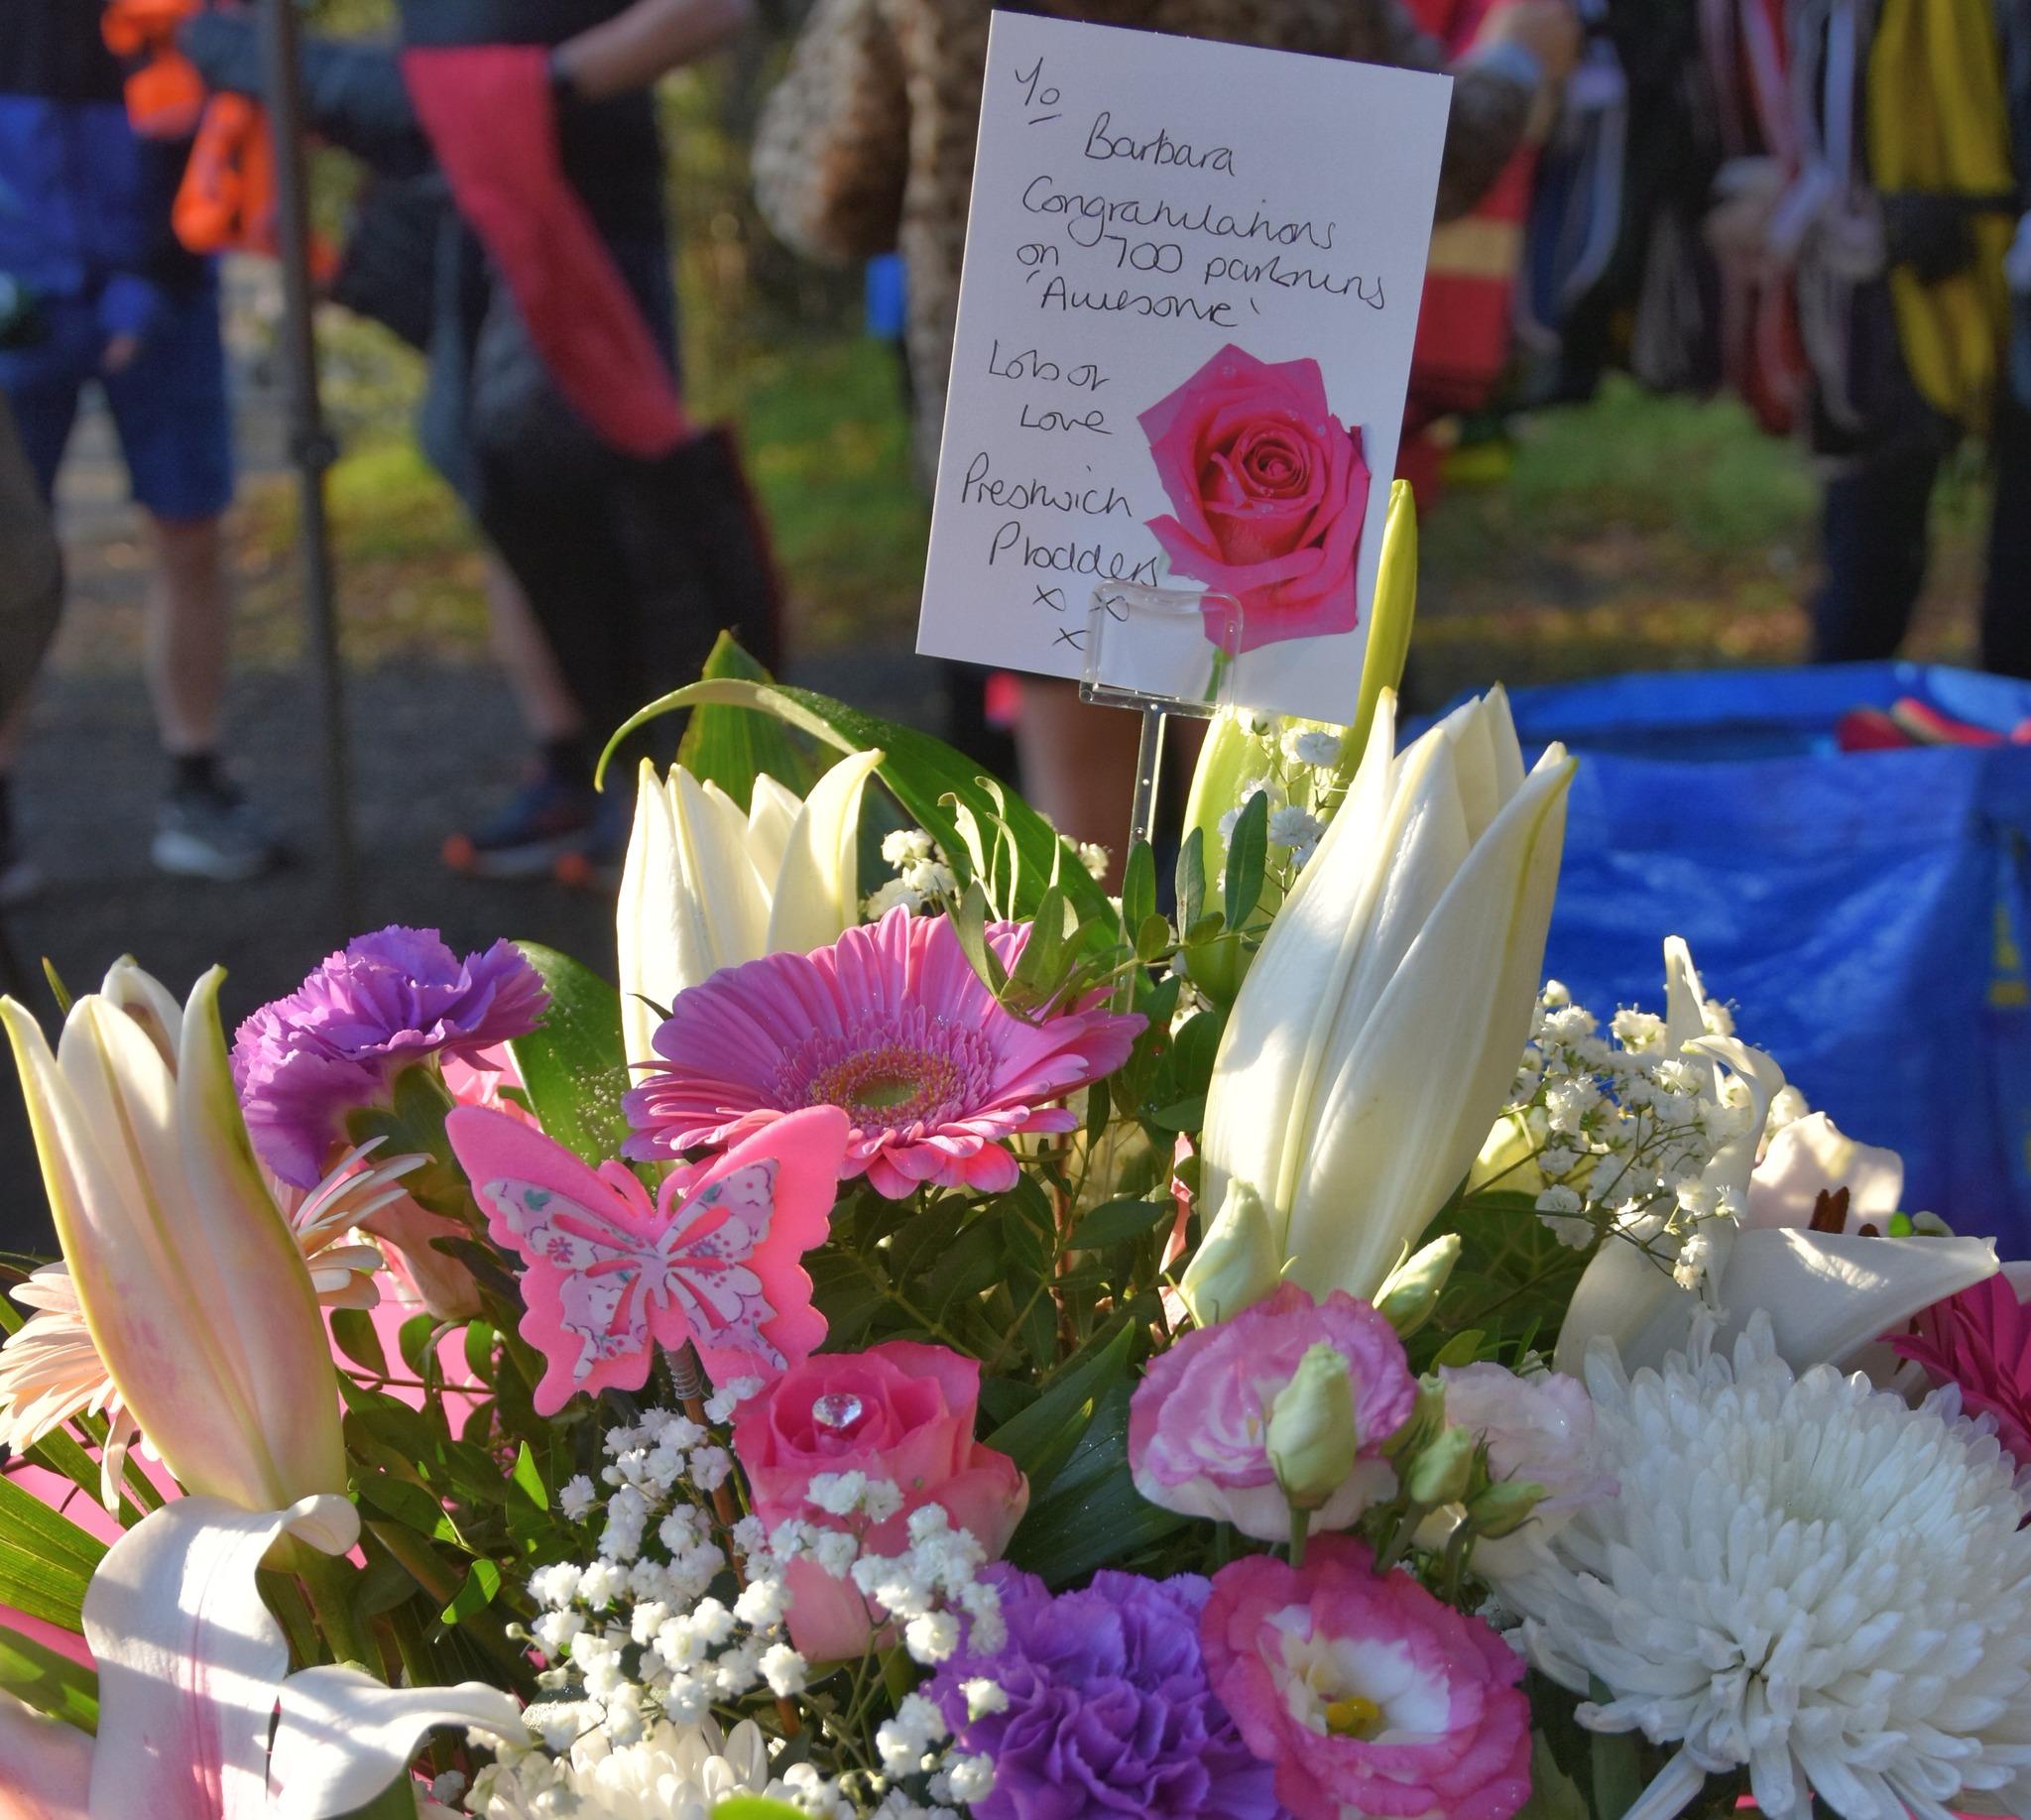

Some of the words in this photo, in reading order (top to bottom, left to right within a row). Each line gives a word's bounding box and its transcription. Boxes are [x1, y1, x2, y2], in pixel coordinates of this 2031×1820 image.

[1084, 111, 1236, 177] Barbara
[1016, 242, 1060, 268] on
[1105, 235, 1183, 274] 700
[1019, 404, 1113, 435] Love
[961, 451, 1133, 518] Prestwich
[989, 521, 1158, 588] Plodders
